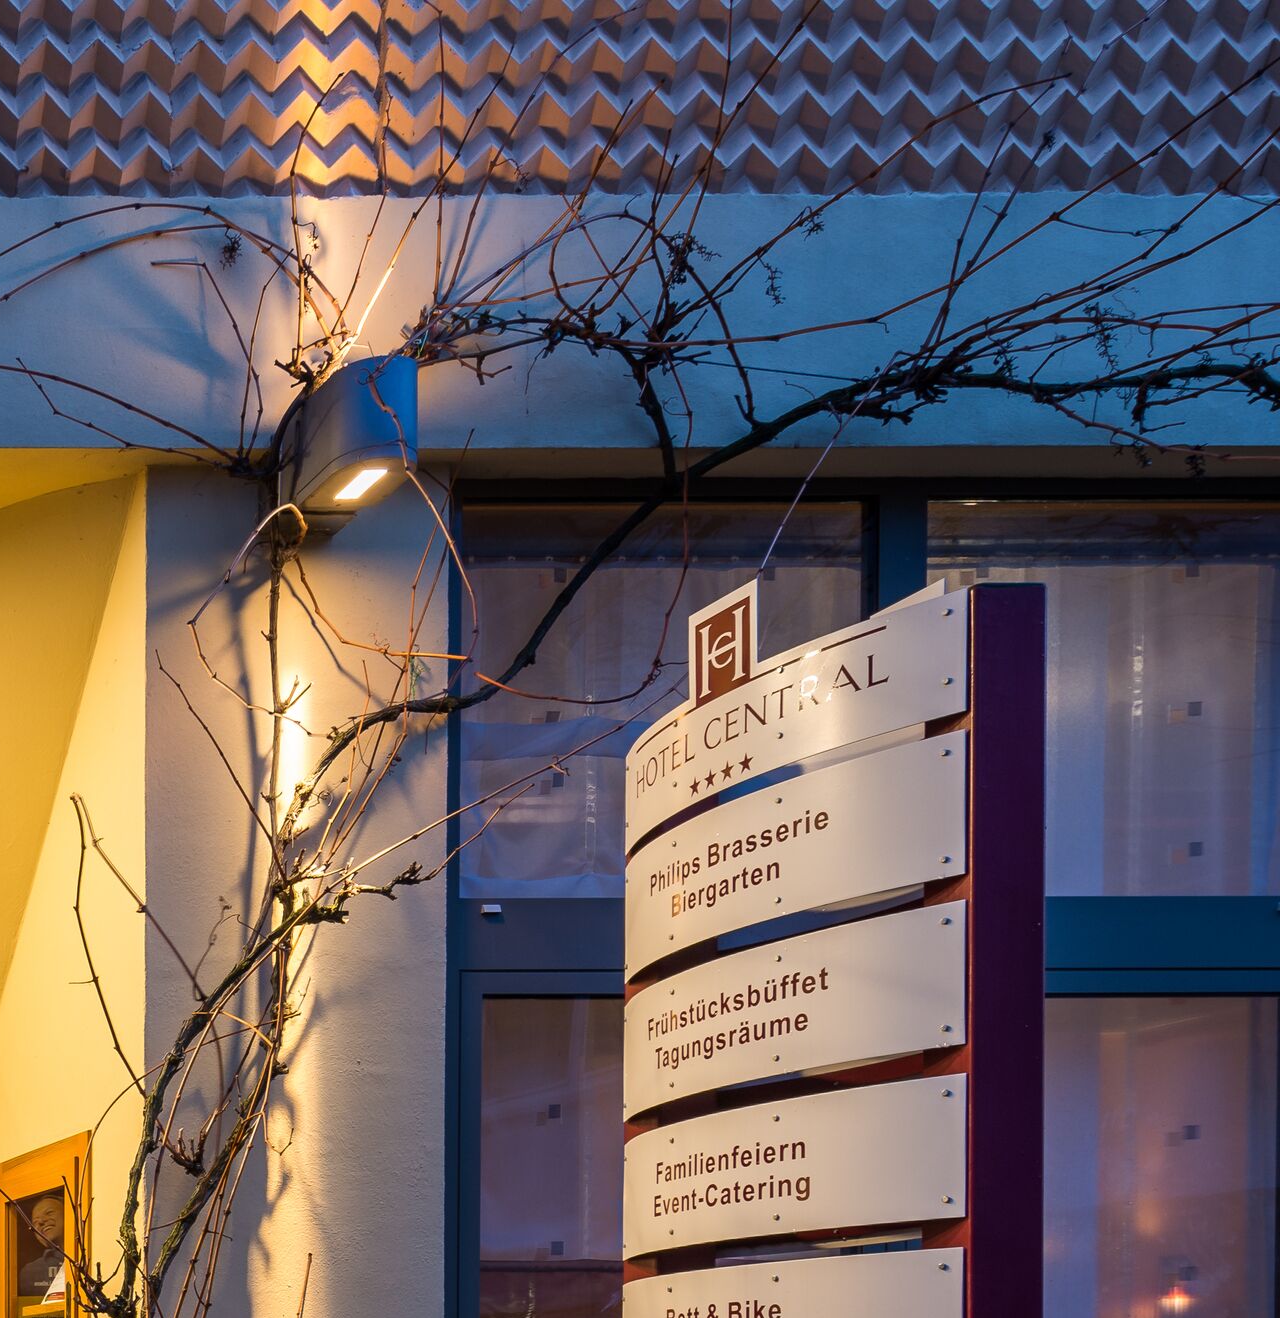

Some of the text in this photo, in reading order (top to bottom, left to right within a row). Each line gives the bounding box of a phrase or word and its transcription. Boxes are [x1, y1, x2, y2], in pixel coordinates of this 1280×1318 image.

[636, 654, 889, 798] HOTEL CENTRAL
[650, 809, 829, 897] Philips Brasserie
[671, 862, 781, 917] Biergarten
[648, 967, 829, 1041] Frühstücksbüffet
[655, 1012, 809, 1070] Tagungsräume
[656, 1138, 806, 1185] Familienfeiern
[654, 1173, 811, 1218] Event-Catering
